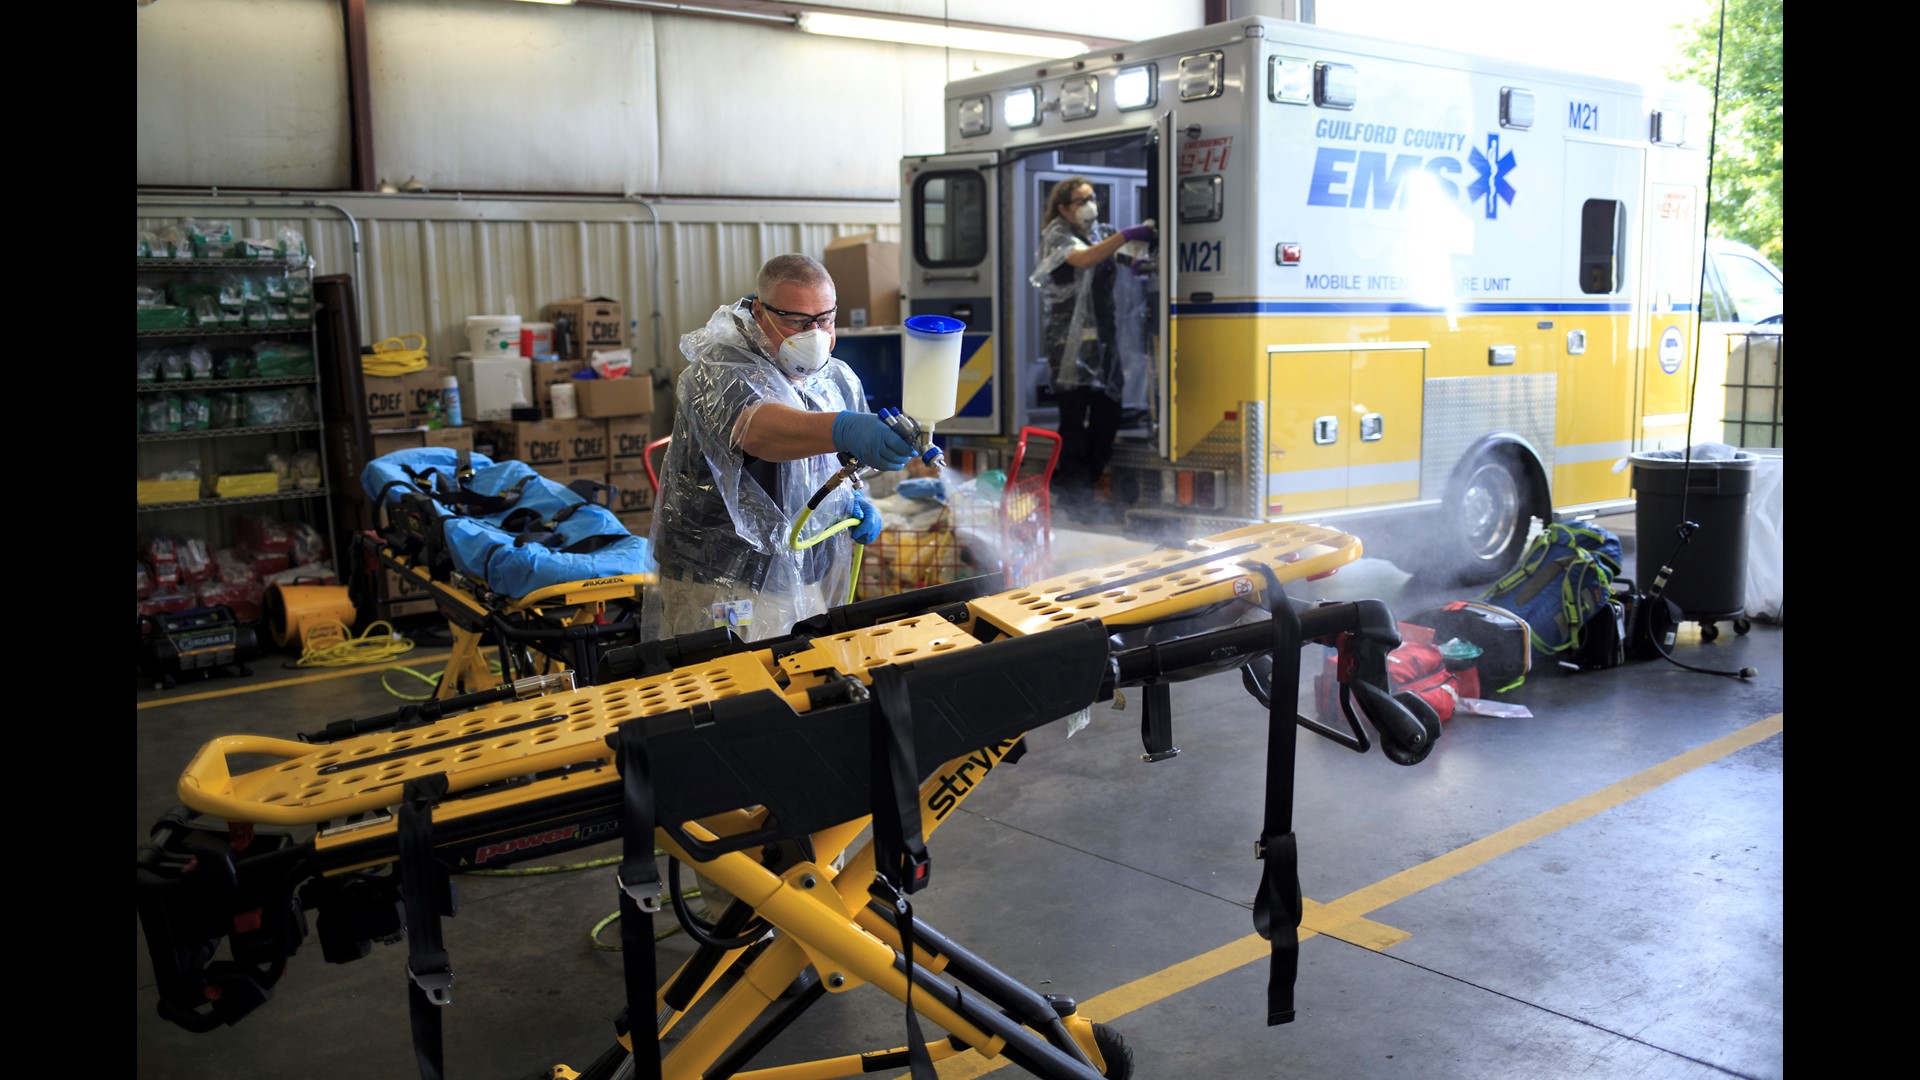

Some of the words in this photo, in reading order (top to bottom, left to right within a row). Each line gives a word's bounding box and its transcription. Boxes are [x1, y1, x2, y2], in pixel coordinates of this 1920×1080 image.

[1569, 101, 1599, 131] M21
[1315, 118, 1398, 145] GUILFORD
[1403, 127, 1467, 152] COUNTY
[1178, 239, 1222, 273] M21
[1305, 273, 1361, 290] MOBILE
[1367, 274, 1409, 291] INTEN
[1483, 277, 1511, 292] UNIT
[928, 739, 1013, 821] stryk
[475, 824, 579, 864] power
